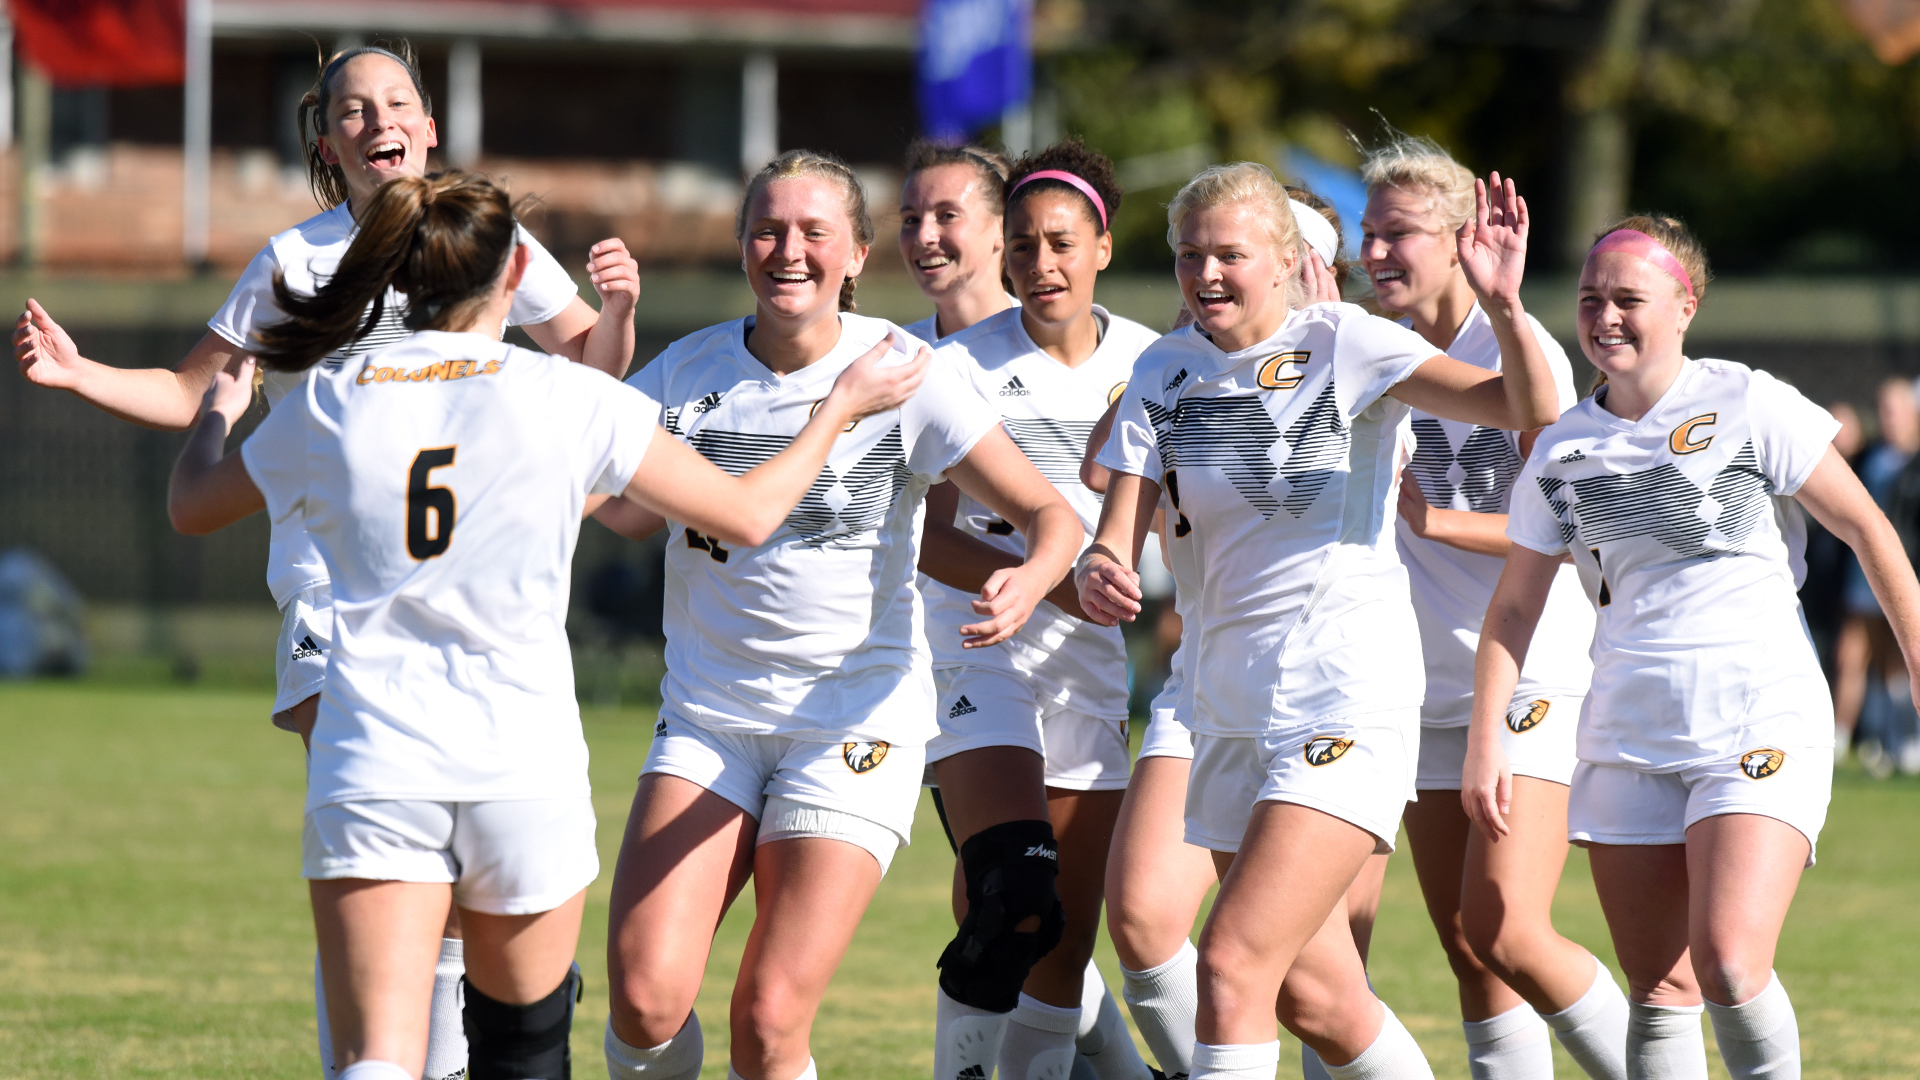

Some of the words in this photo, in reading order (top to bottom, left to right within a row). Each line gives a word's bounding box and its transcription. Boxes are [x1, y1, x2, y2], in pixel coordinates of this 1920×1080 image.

[356, 359, 502, 386] COLONELS
[1256, 350, 1312, 391] C
[999, 388, 1031, 397] adidas
[1668, 412, 1718, 456] C
[404, 444, 458, 563] 6
[292, 648, 323, 661] adidas
[949, 706, 977, 719] adidas
